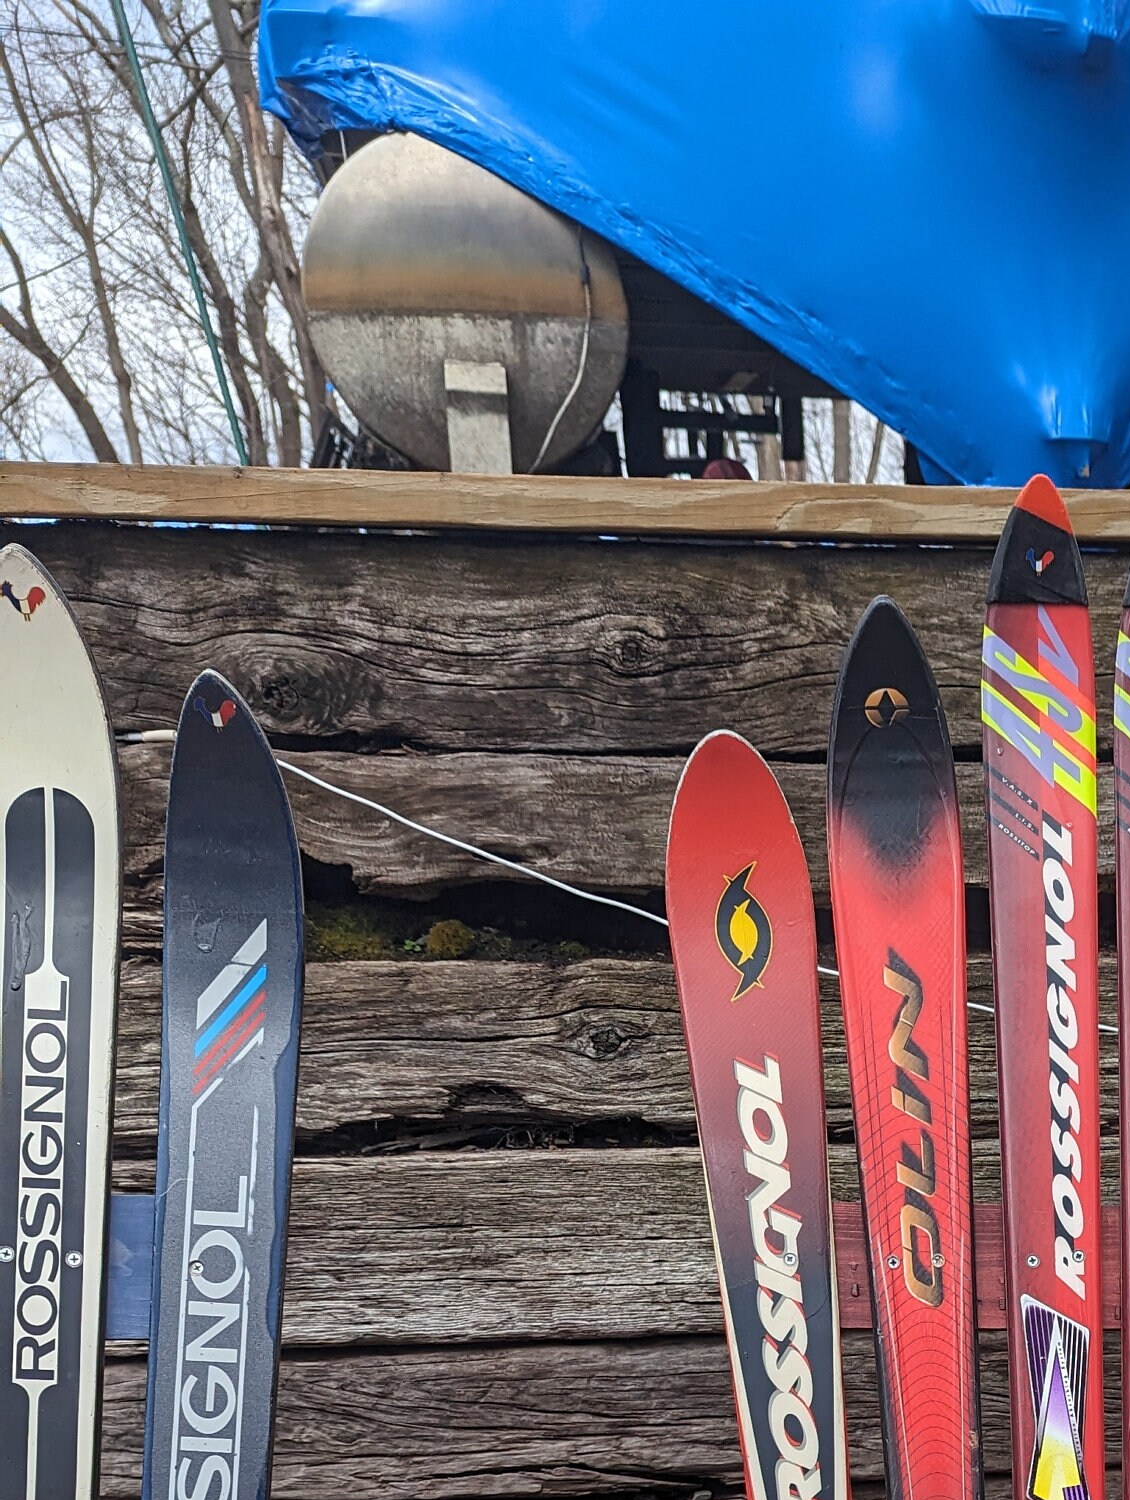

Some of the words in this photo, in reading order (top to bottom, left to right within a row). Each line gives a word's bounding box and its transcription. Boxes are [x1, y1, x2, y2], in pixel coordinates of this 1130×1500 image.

[998, 823, 1036, 855] ROSSITOP
[16, 980, 67, 1382] ROSSIGNOL
[883, 958, 945, 1307] OLIN
[1042, 820, 1086, 1300] ROSSIGNOL
